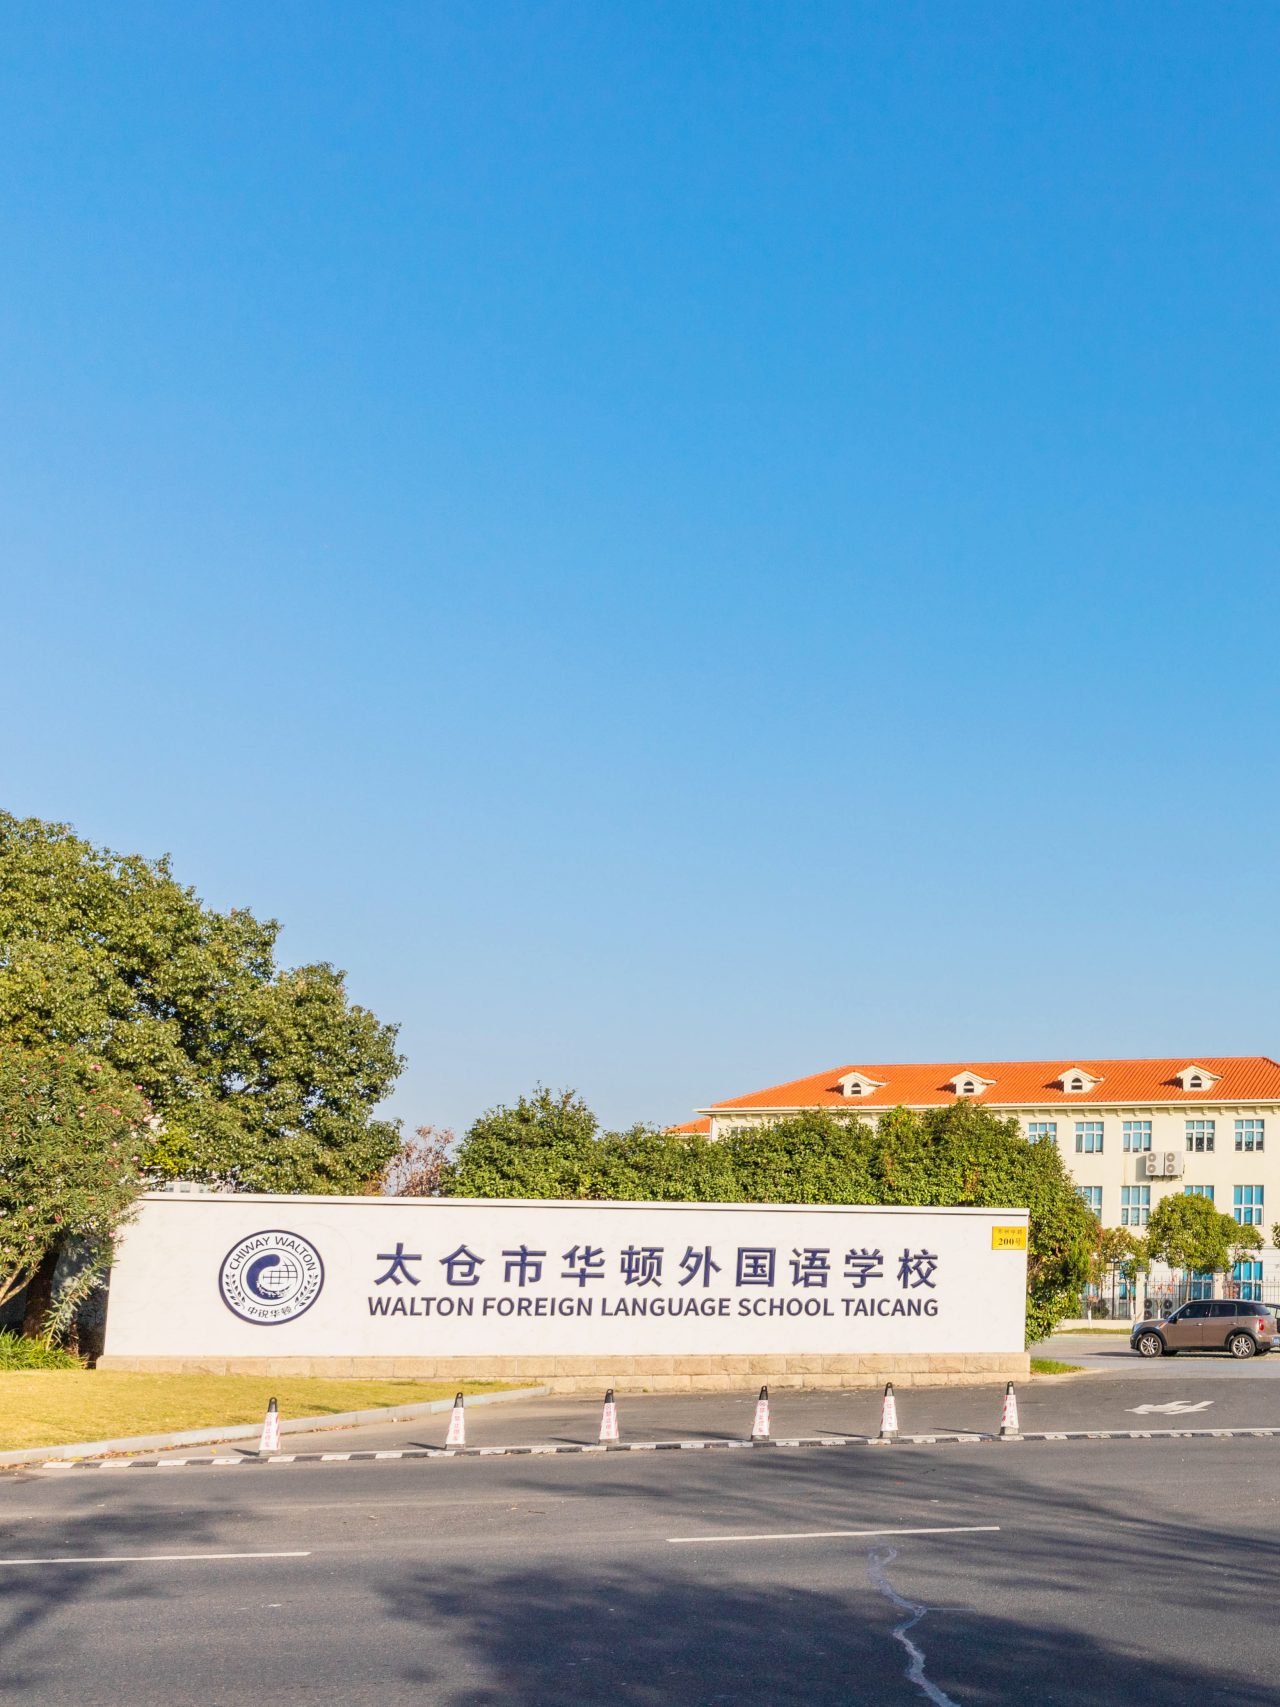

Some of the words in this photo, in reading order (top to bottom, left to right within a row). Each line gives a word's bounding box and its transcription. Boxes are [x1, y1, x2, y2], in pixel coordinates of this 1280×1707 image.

[229, 1236, 270, 1270] CHIWAY
[275, 1236, 316, 1271] WALTON
[998, 1237, 1021, 1246] 200号
[373, 1242, 939, 1289] 太仓市华顿外国语学校
[368, 1296, 474, 1317] WALTON
[482, 1297, 593, 1317] FOREIGN
[601, 1298, 731, 1317] LANGUAGE
[738, 1298, 834, 1317] SCHOOL
[841, 1298, 939, 1317] TAICANG
